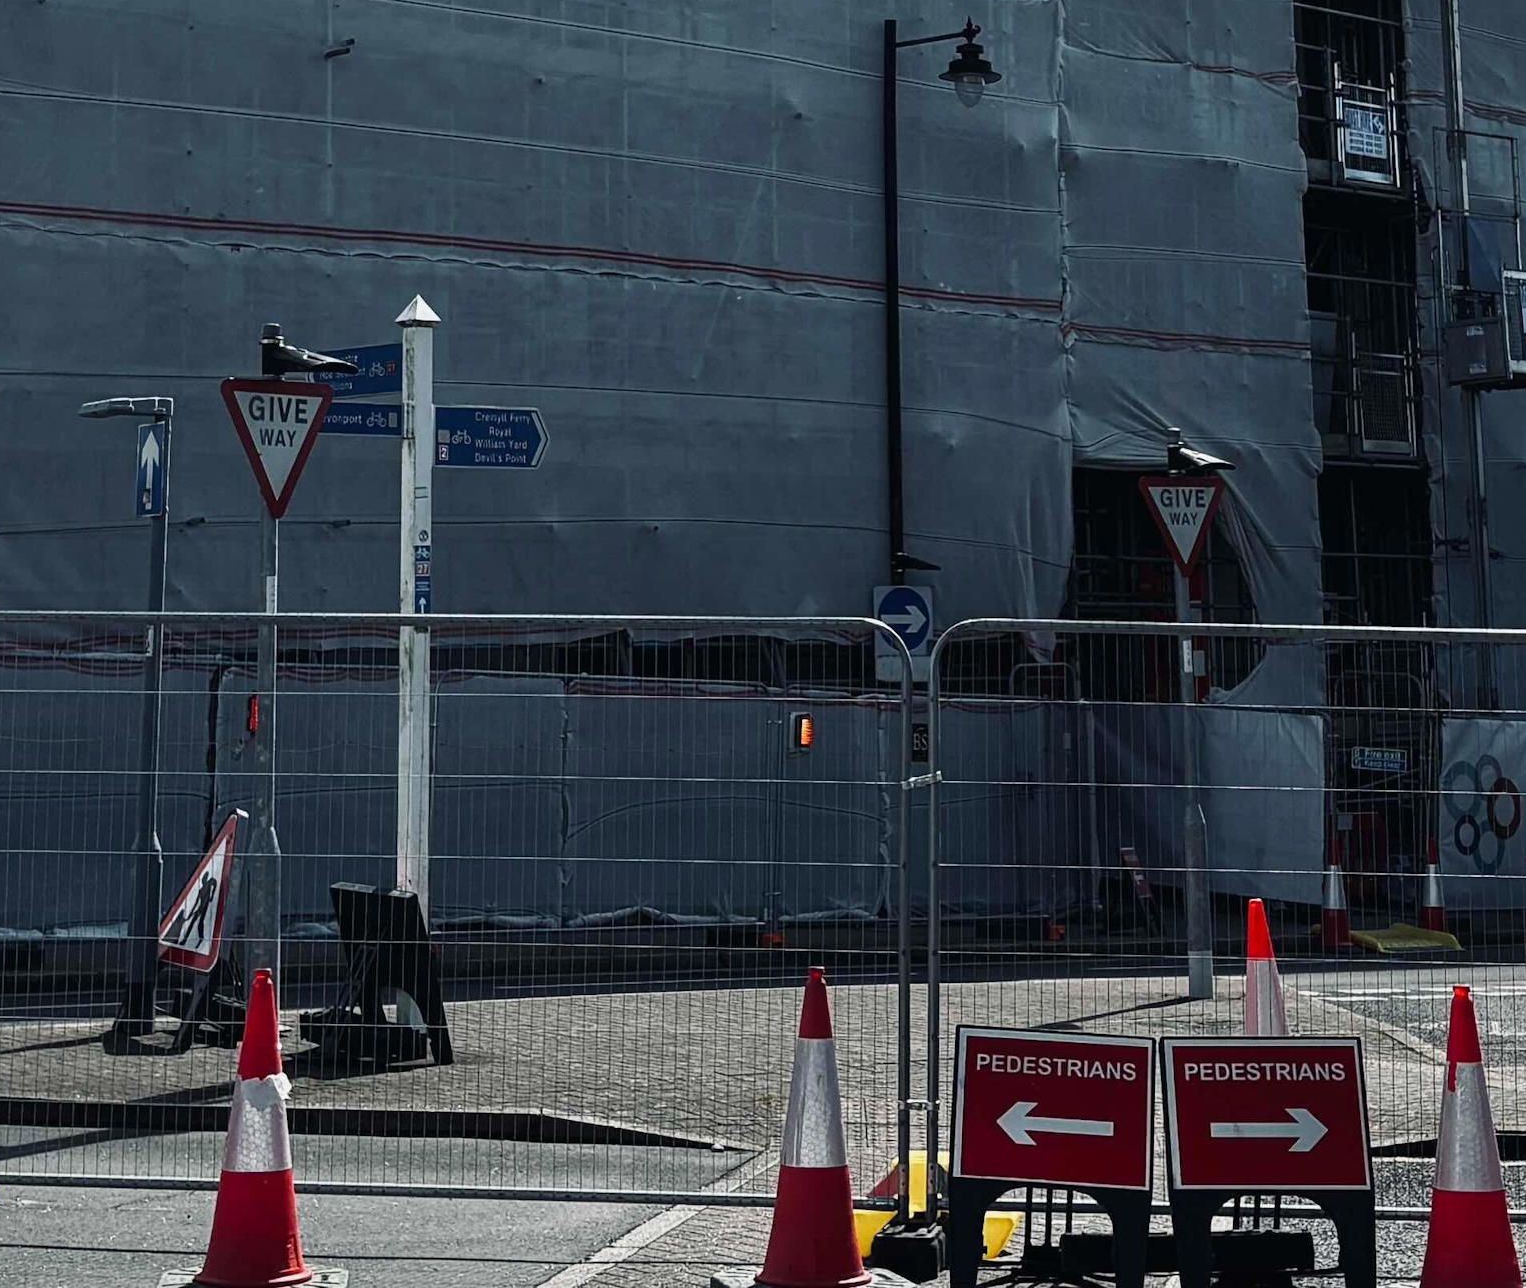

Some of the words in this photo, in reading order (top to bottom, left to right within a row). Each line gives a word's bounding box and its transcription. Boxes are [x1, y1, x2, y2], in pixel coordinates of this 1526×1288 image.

[248, 395, 308, 424] GIVE
[510, 412, 531, 424] Ferry
[259, 428, 297, 447] WAY
[488, 426, 513, 438] Royal
[475, 439, 506, 450] William
[508, 440, 528, 450] Yard
[474, 452, 503, 463] Devil's
[505, 453, 527, 464] Point
[1160, 488, 1207, 509] GIVE
[1169, 512, 1198, 527] WAY
[976, 1053, 1137, 1082] PEDESTRIANS
[1184, 1062, 1346, 1082] PEDESTRIANS
